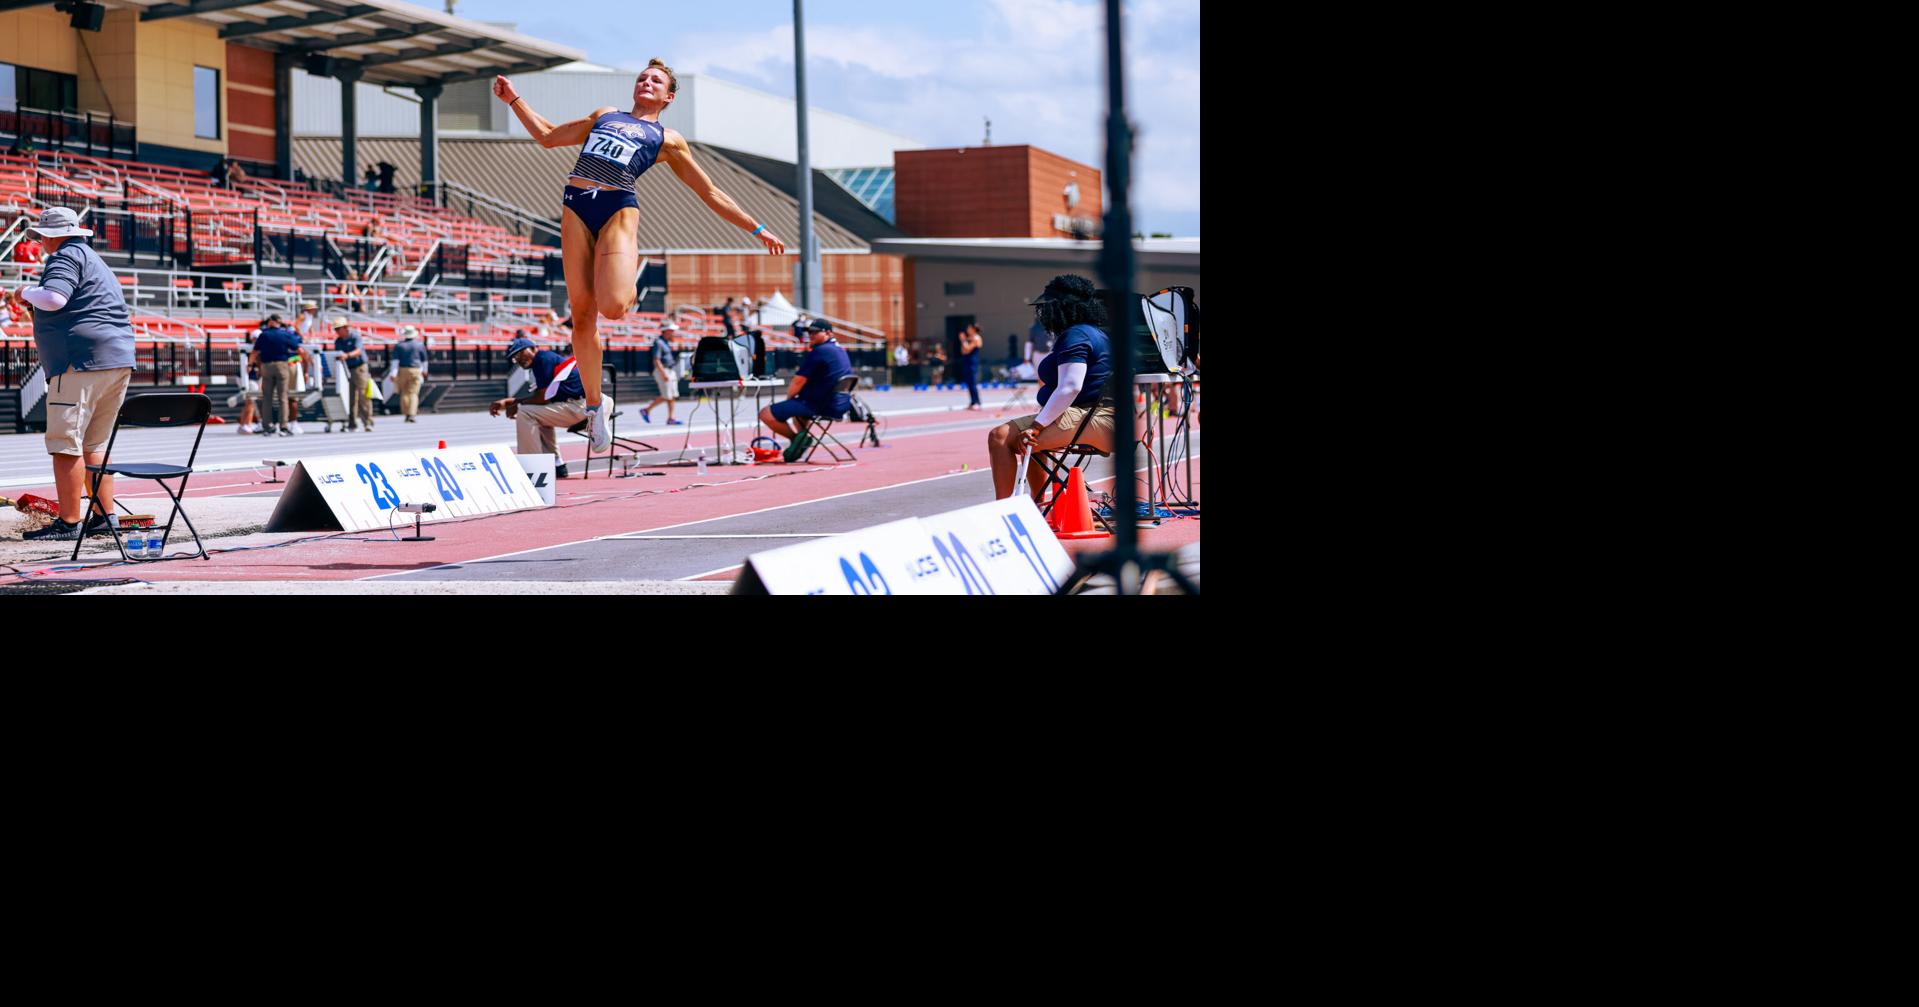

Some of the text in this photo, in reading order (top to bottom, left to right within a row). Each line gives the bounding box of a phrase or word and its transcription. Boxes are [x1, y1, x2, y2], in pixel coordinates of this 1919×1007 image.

[591, 137, 624, 159] 740
[321, 473, 345, 484] UCS
[355, 462, 401, 510] 23
[420, 456, 465, 502] 20
[479, 452, 514, 495] 17
[1001, 513, 1059, 595] 17
